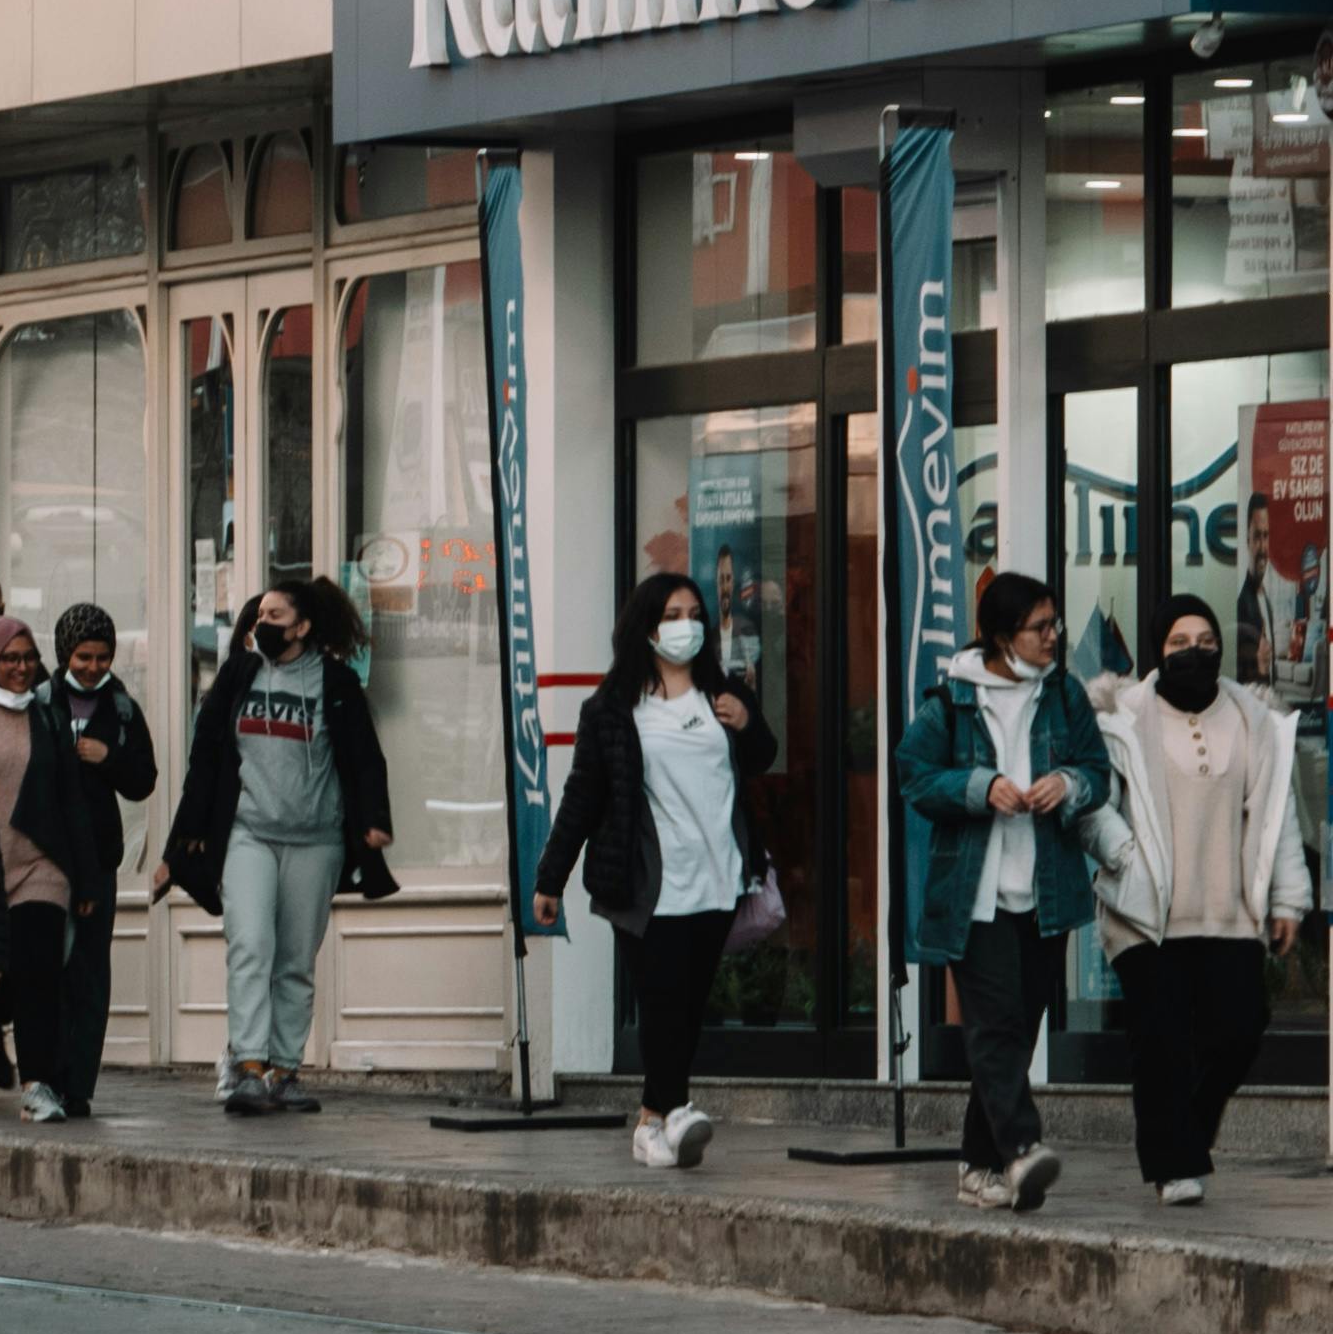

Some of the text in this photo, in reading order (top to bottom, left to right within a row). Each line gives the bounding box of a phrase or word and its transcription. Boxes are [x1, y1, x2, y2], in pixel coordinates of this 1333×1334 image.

[1309, 453, 1324, 475] DE
[1273, 479, 1288, 501] EV
[1294, 500, 1324, 523] OLUN
